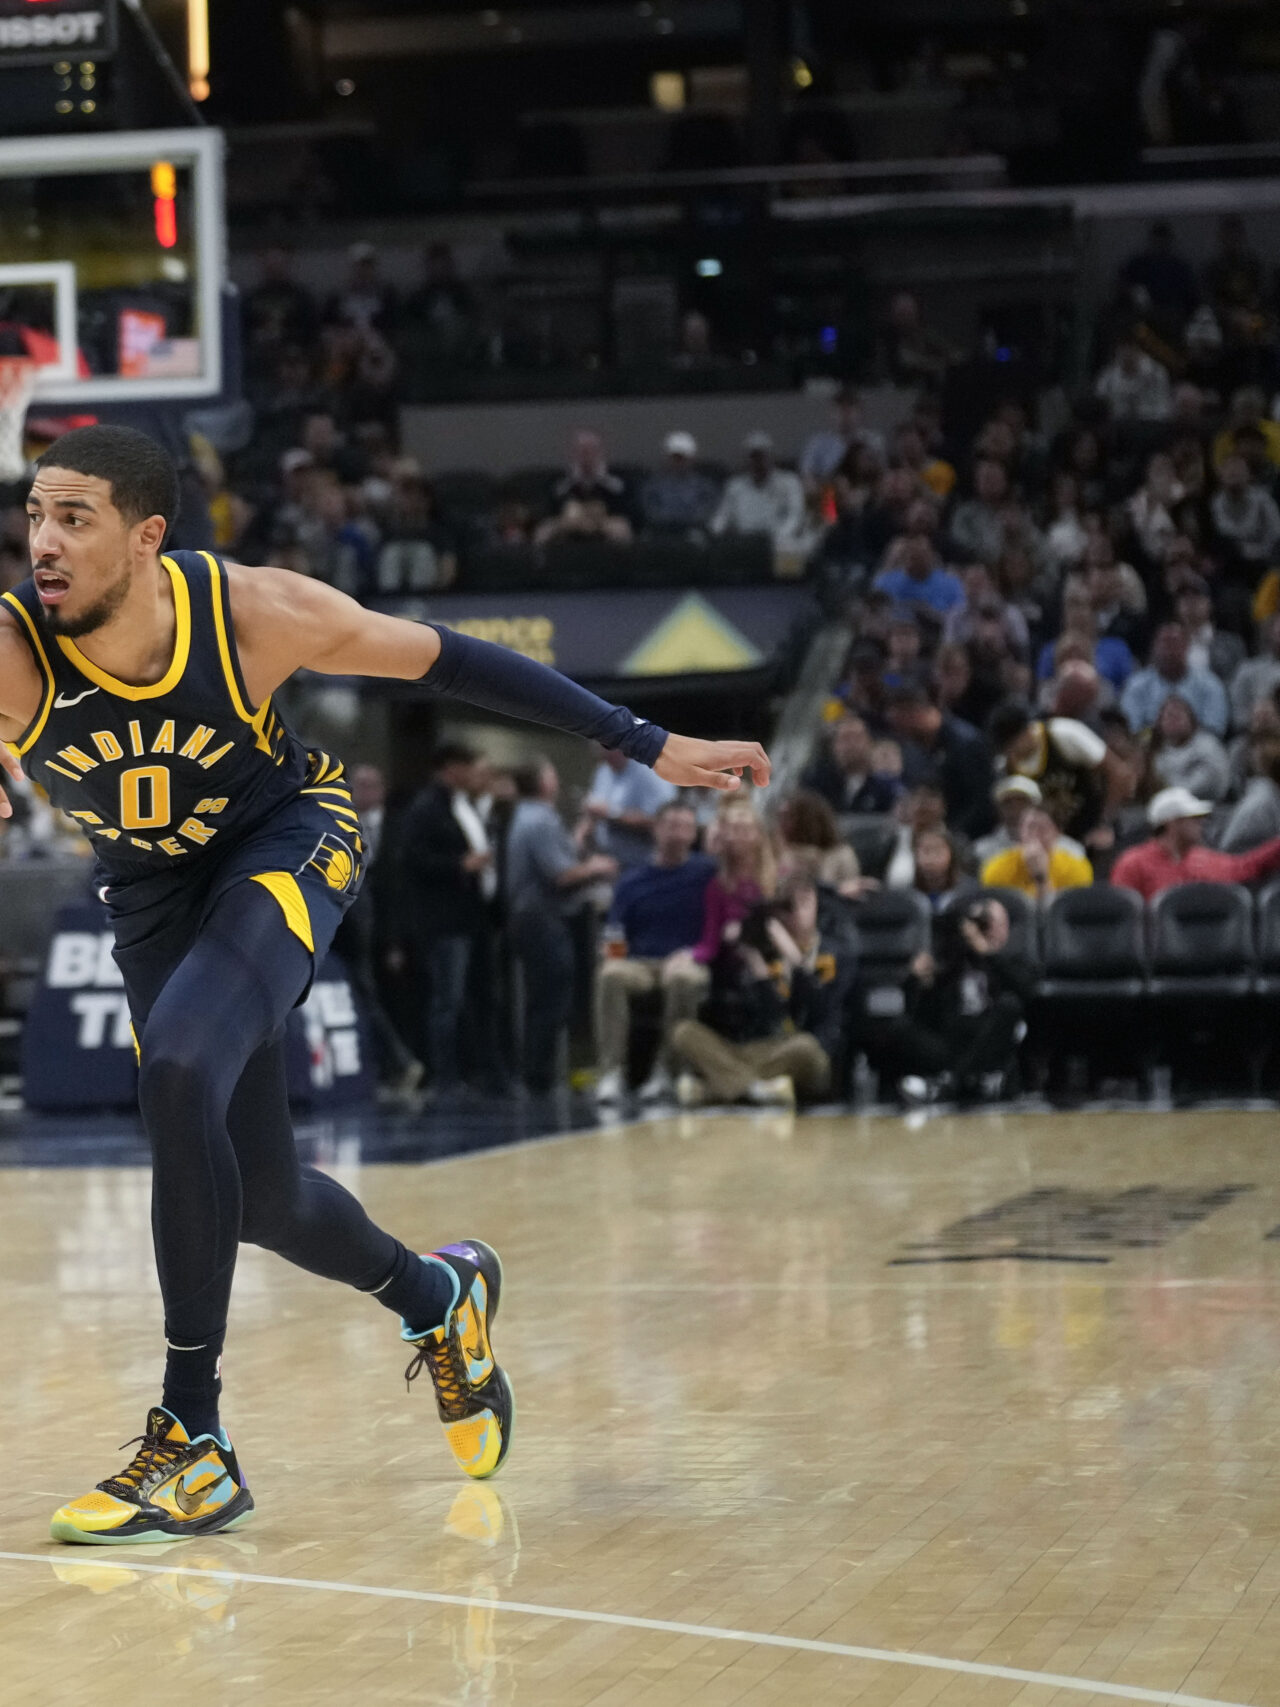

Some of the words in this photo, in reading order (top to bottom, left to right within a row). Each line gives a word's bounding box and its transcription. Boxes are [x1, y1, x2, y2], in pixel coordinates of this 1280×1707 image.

[45, 719, 235, 782] INDIANA
[70, 797, 229, 856] PACERS
[121, 765, 171, 830] 0
